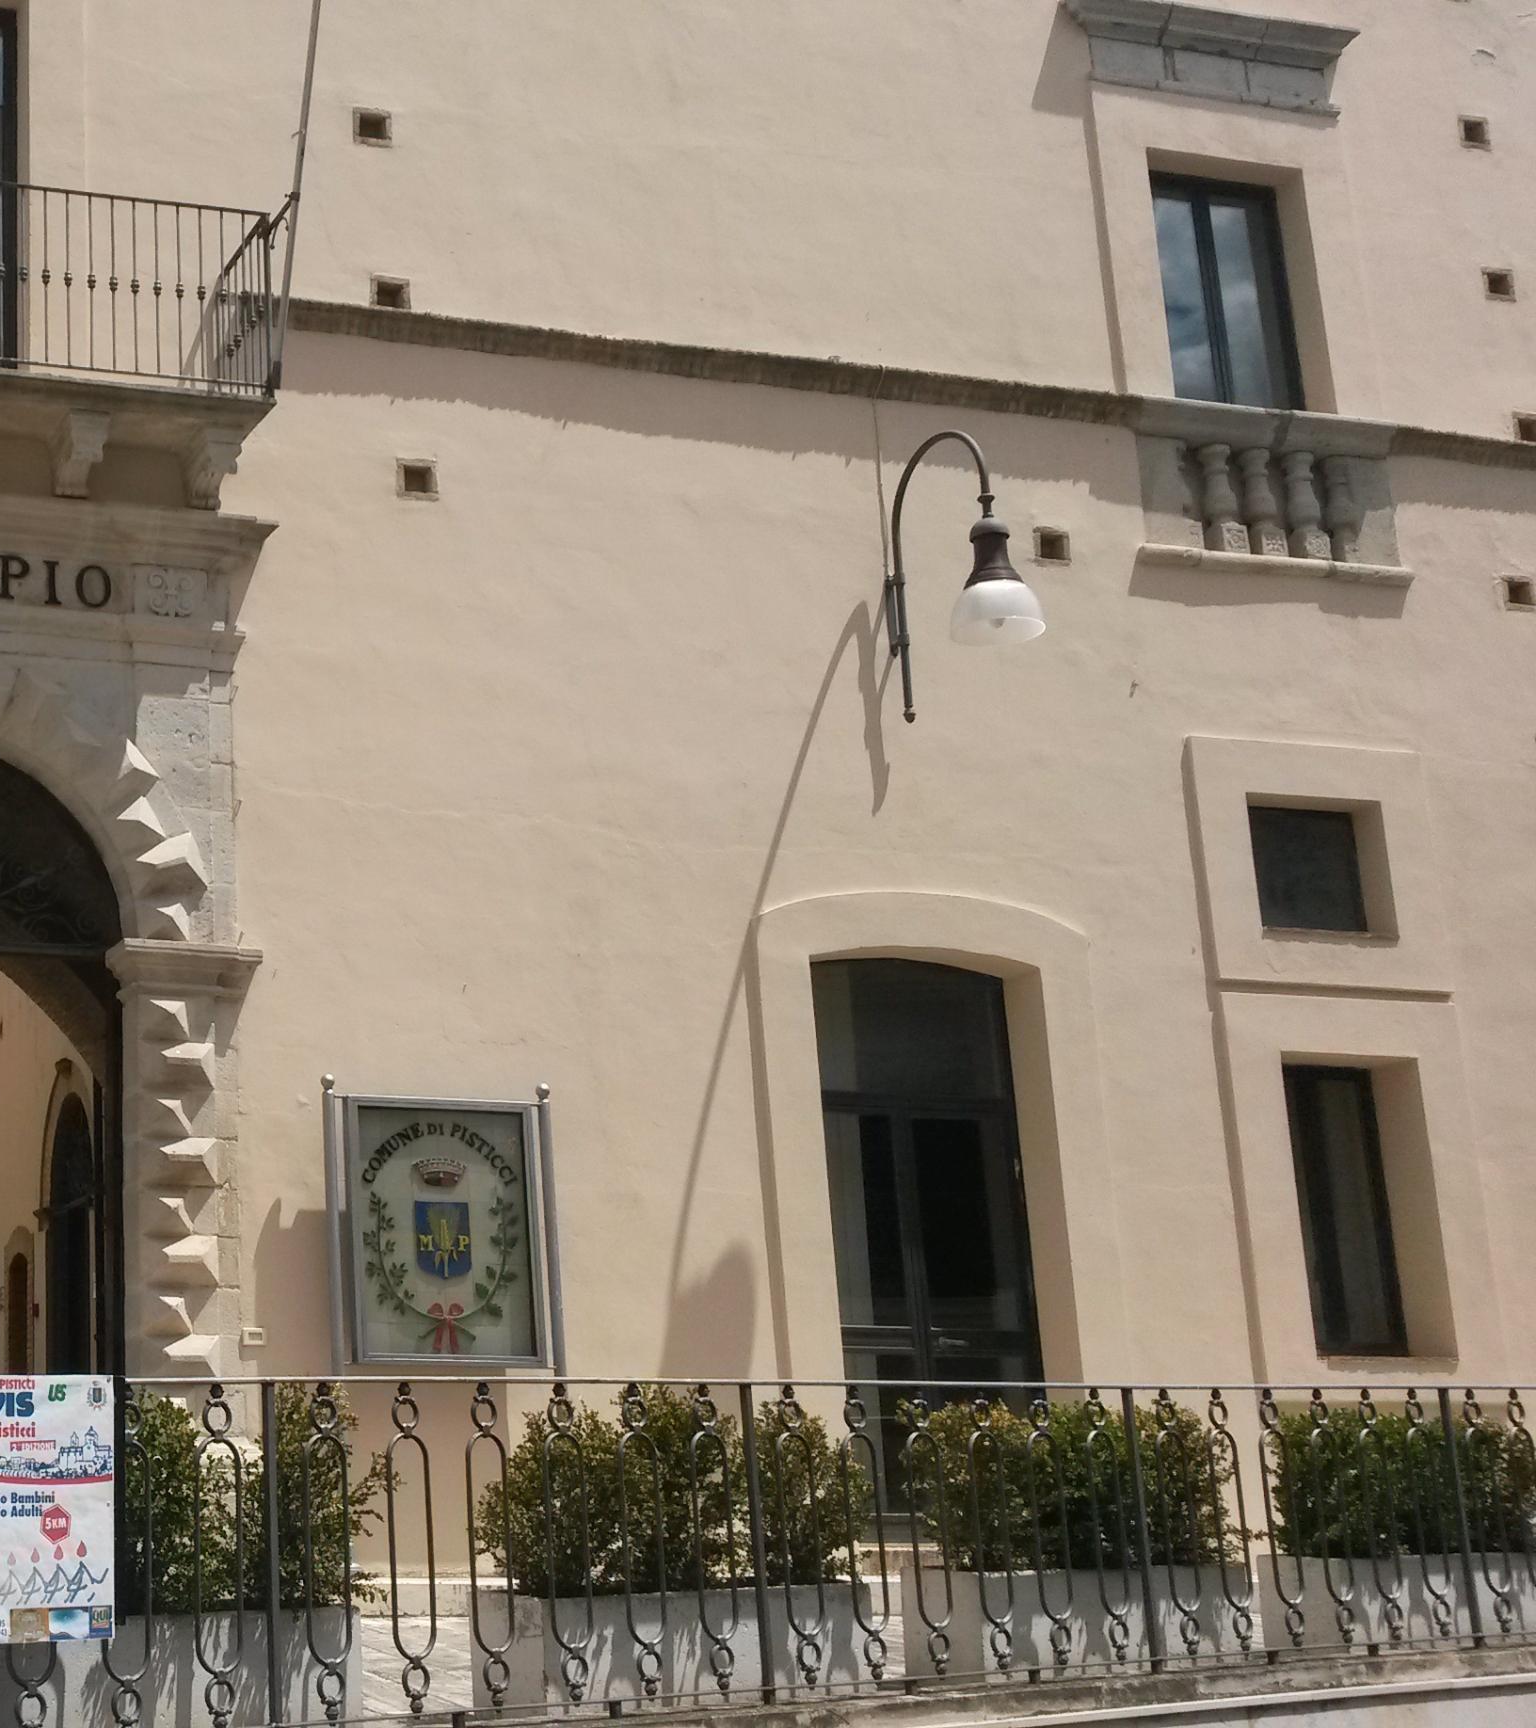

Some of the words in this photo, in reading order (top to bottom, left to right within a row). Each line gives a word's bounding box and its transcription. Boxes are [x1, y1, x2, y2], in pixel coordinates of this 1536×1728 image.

[362, 1122, 424, 1184] COMUNE
[427, 1122, 444, 1136] DI
[450, 1122, 518, 1187] PISTICCI
[418, 1235, 433, 1251] M
[458, 1235, 470, 1251] P
[0, 1378, 35, 1389] PISTICCI
[11, 1490, 55, 1504] Bambini
[11, 1504, 42, 1517] Adulti
[45, 1517, 66, 1530] 5KM
